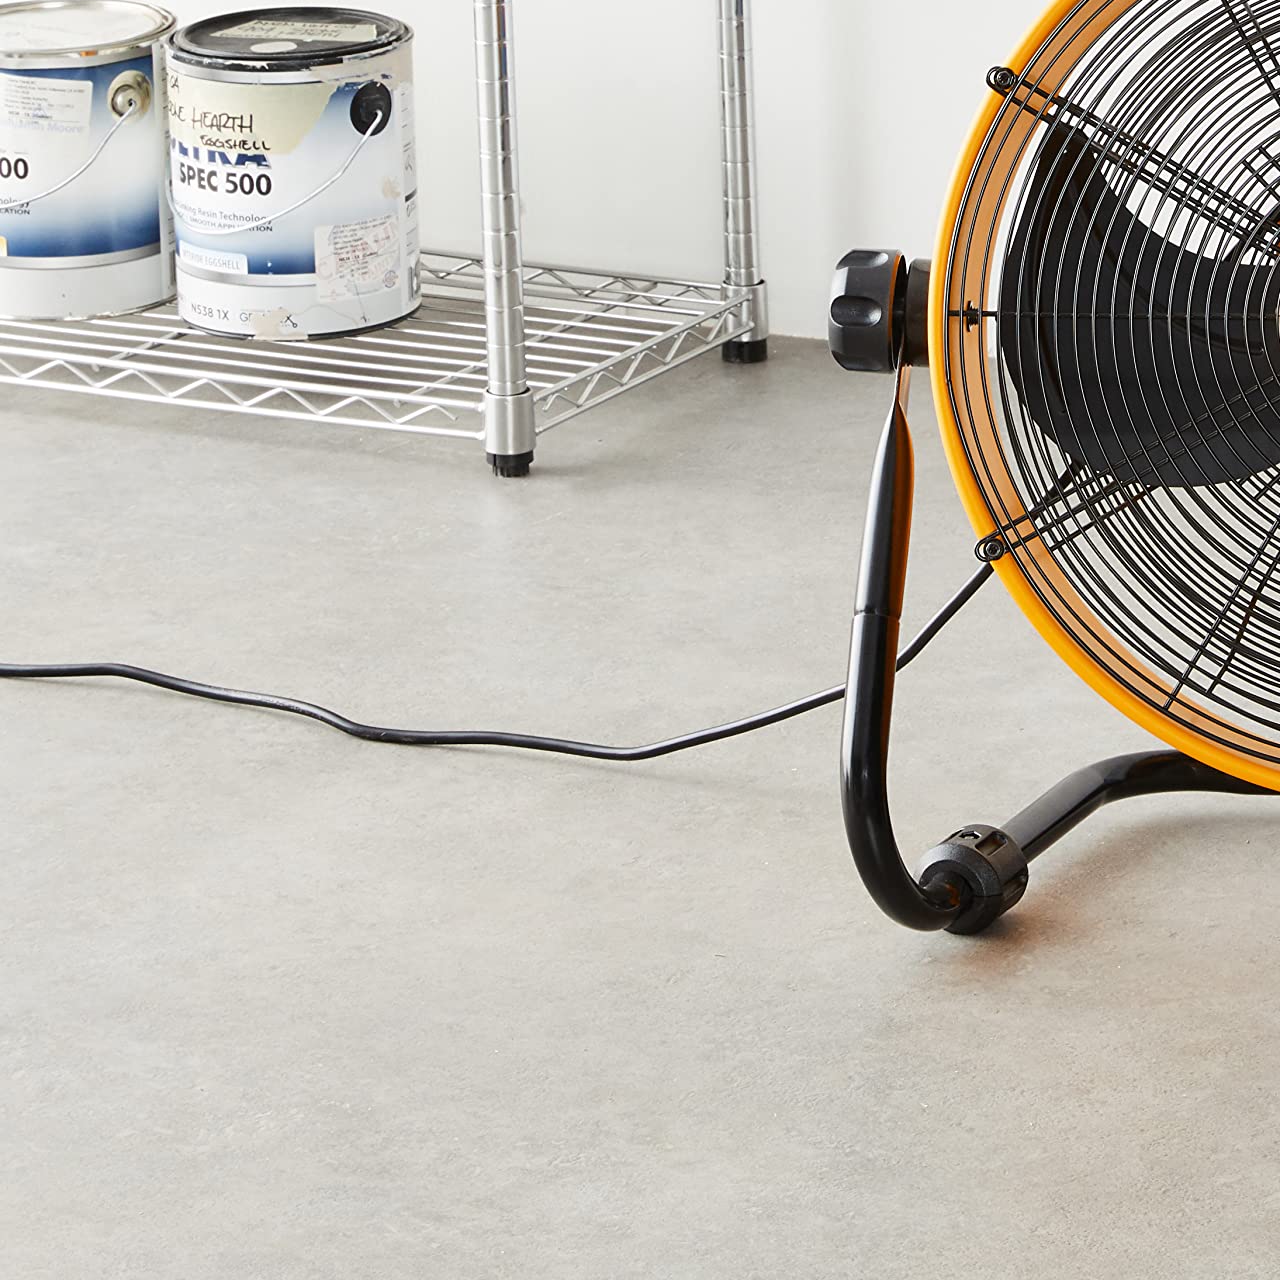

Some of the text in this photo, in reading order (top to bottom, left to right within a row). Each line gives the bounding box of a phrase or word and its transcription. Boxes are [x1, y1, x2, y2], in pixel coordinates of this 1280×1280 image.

[191, 106, 253, 134] HEARTH
[200, 134, 271, 151] EGGSHELL
[180, 161, 273, 196] SPEC 500
[198, 207, 218, 219] Resin
